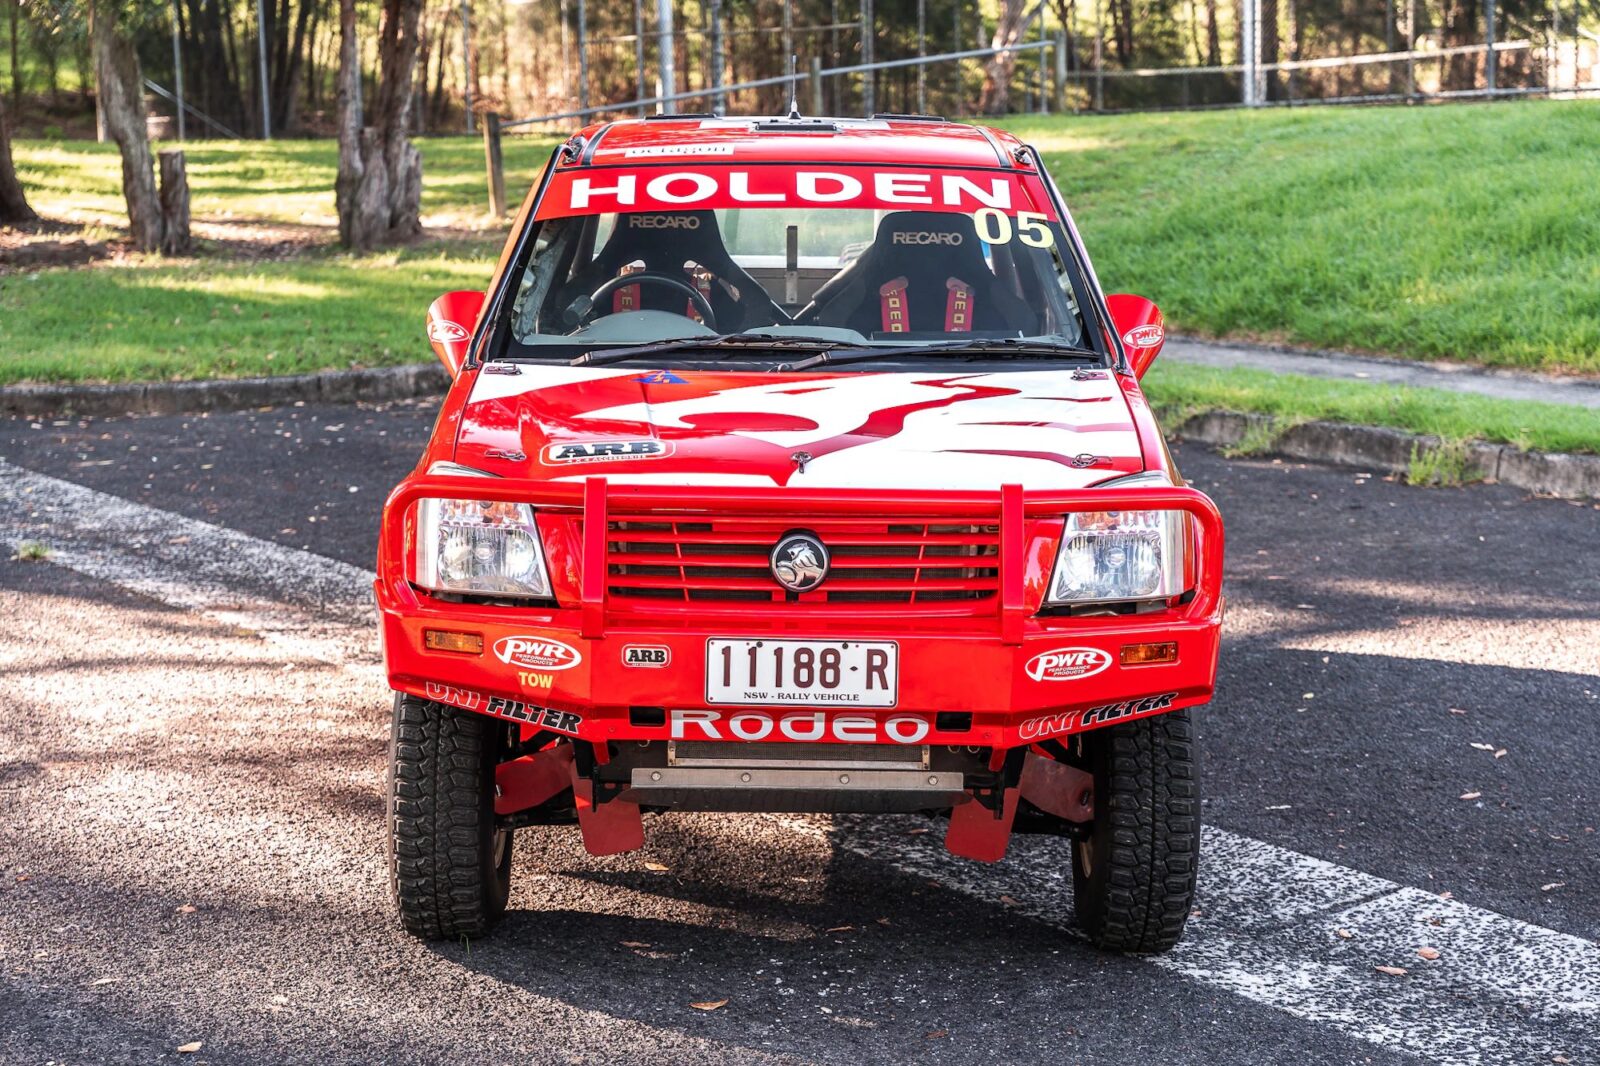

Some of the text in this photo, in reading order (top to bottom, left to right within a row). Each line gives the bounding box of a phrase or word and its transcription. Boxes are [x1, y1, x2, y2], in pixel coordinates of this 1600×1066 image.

[570, 171, 1012, 209] HOLDEN
[629, 215, 700, 230] RECARO
[973, 207, 1055, 248] 05
[892, 231, 963, 246] RECARO
[555, 440, 661, 459] ARB
[502, 639, 574, 665] PWR
[627, 649, 666, 663] ARB
[1035, 651, 1104, 681] PWR
[518, 671, 554, 689] TOW
[425, 681, 583, 734] UNI FILTER
[743, 691, 769, 700] NSW
[777, 692, 811, 701] RALLY
[813, 693, 860, 702] VEHICLE
[1018, 692, 1179, 740] UNI FILTER
